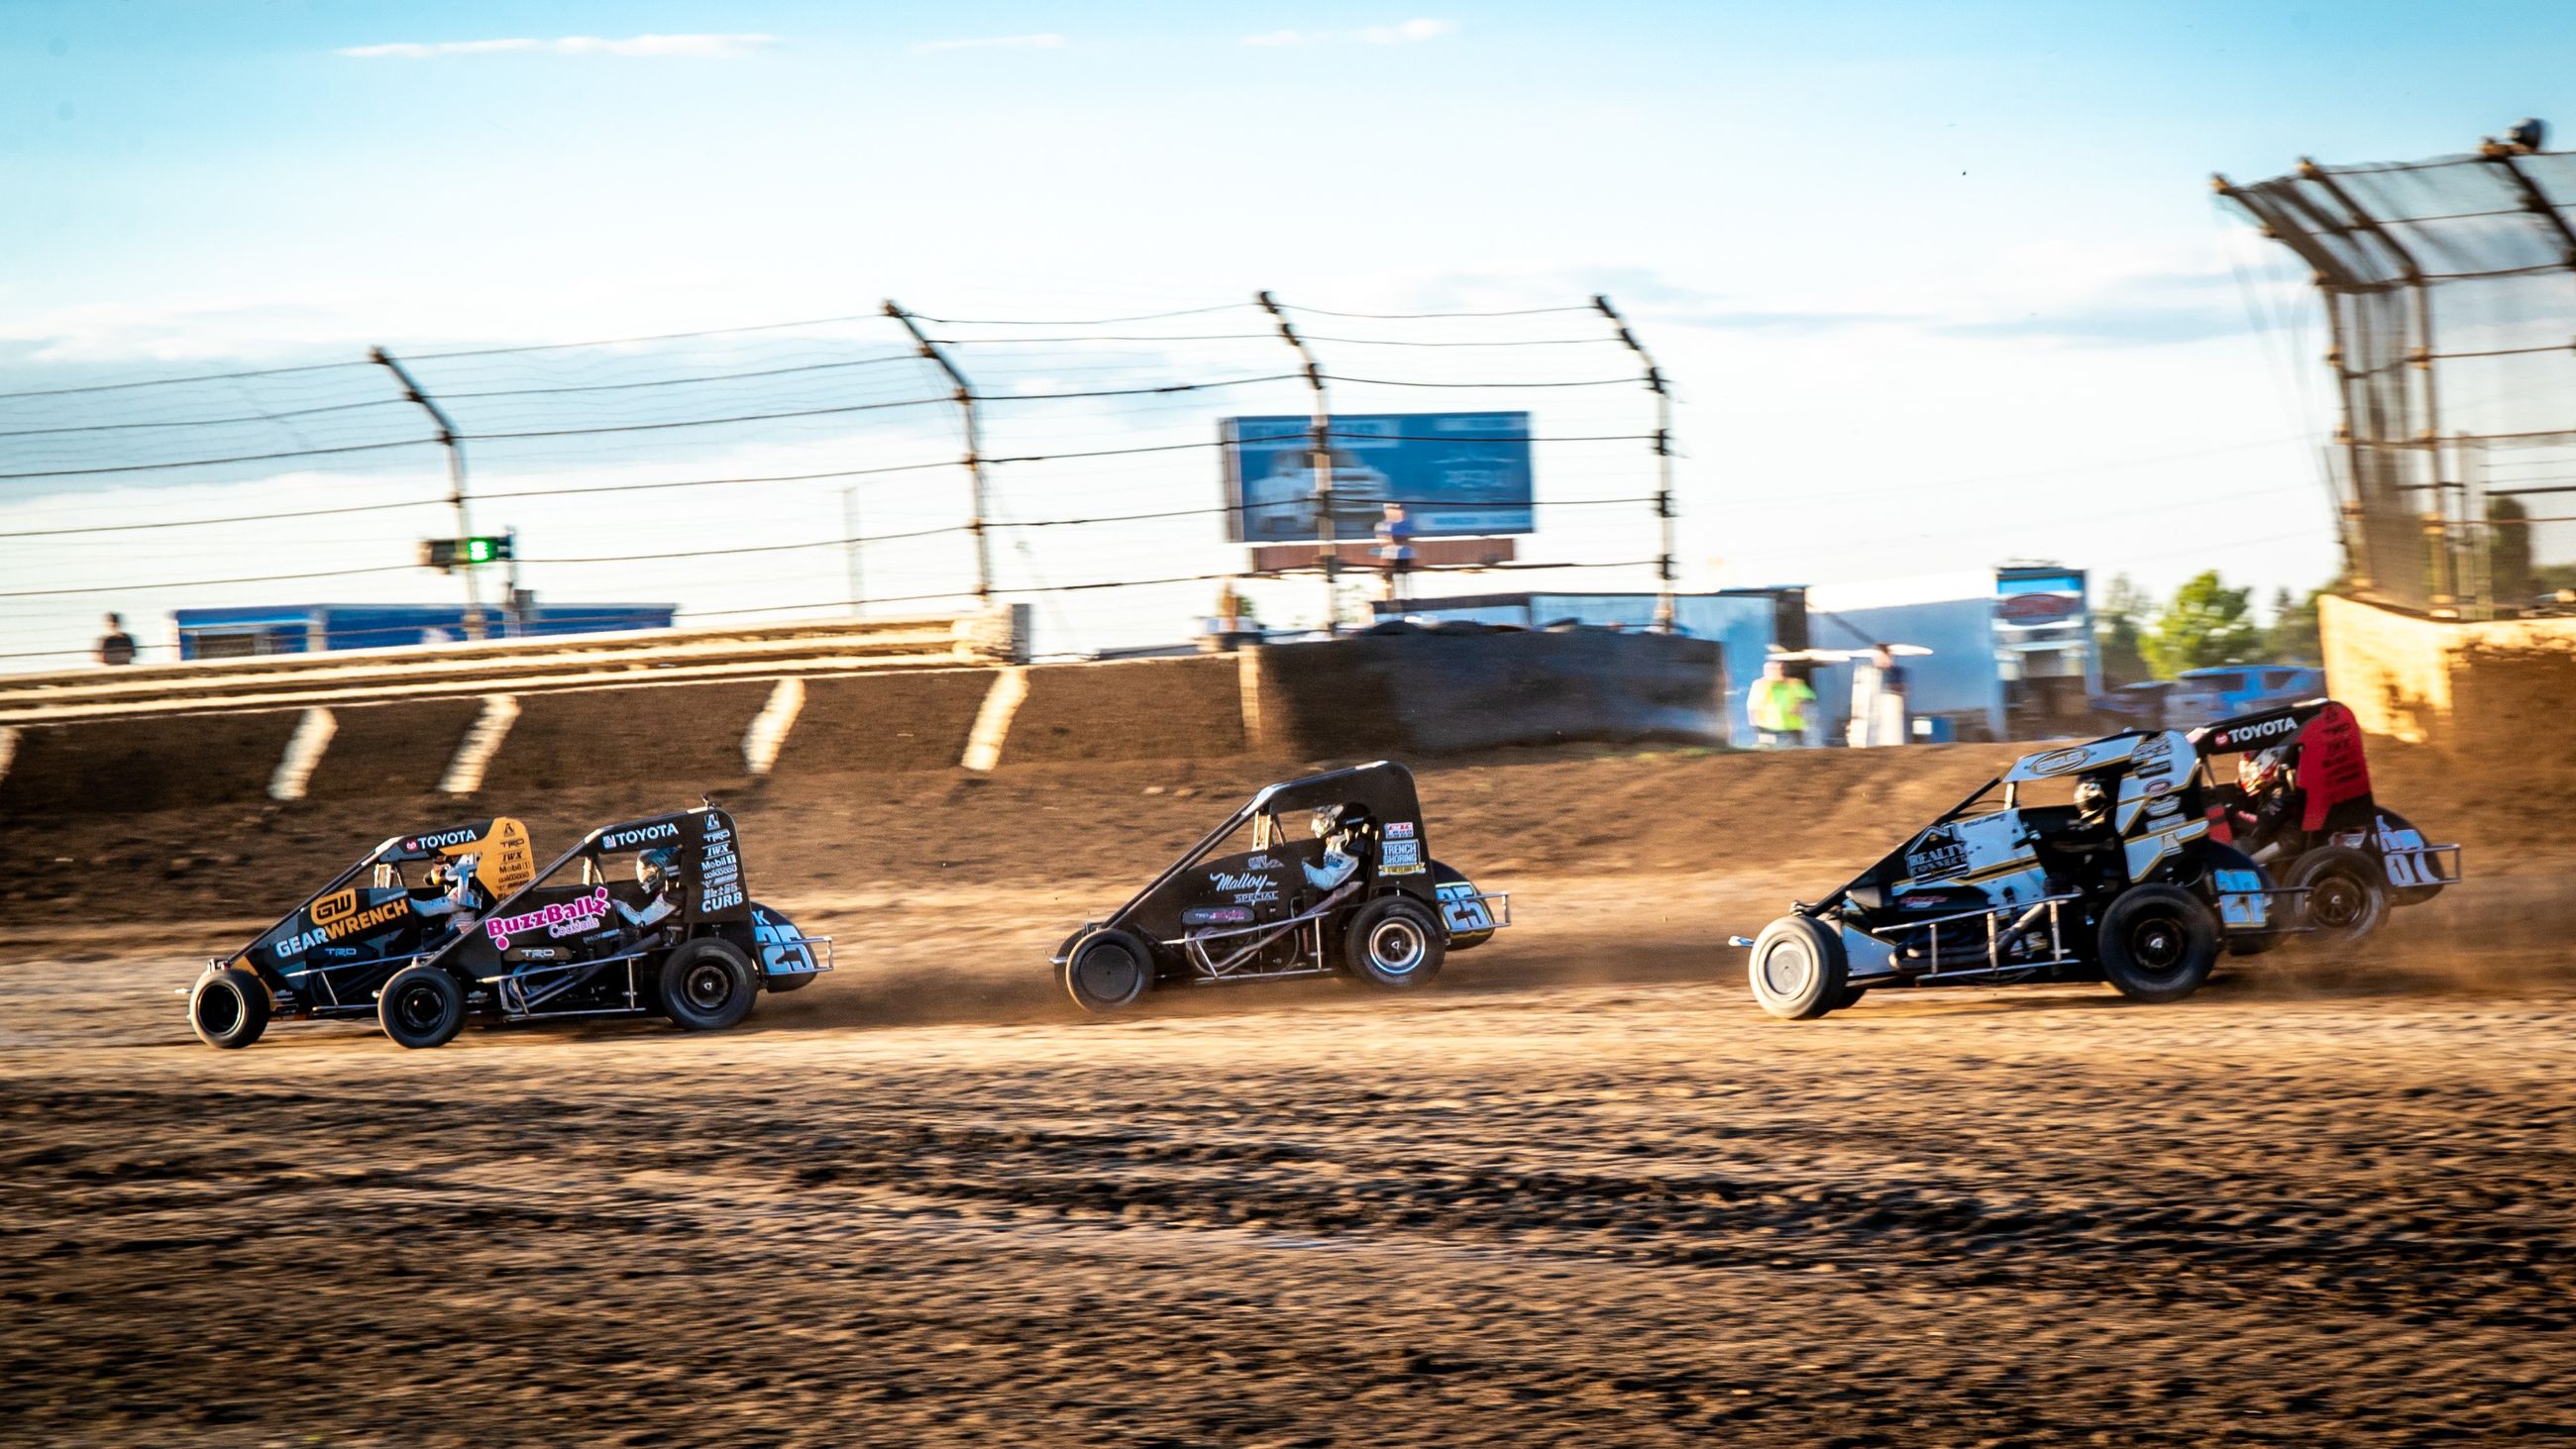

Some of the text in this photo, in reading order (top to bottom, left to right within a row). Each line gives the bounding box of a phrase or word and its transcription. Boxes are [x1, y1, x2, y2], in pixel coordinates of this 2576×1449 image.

[2228, 716, 2299, 744] TOYOTA
[417, 829, 478, 850] TOYOTA
[615, 822, 679, 845] TOYOTA
[1383, 842, 1418, 857] TRENCH
[1908, 842, 1967, 867] REALTY
[498, 864, 522, 874] Mobil
[700, 859, 726, 872] Mobil
[1210, 873, 1277, 906] Malloy
[1234, 891, 1278, 903] SPECIAL
[701, 891, 743, 913] CURB
[1436, 885, 1492, 931] 25
[275, 898, 409, 959] GEARWRENCH
[549, 916, 600, 939] Cocktails
[324, 947, 357, 957] TRD
[520, 948, 556, 959] TRD
[754, 925, 815, 976] 25
